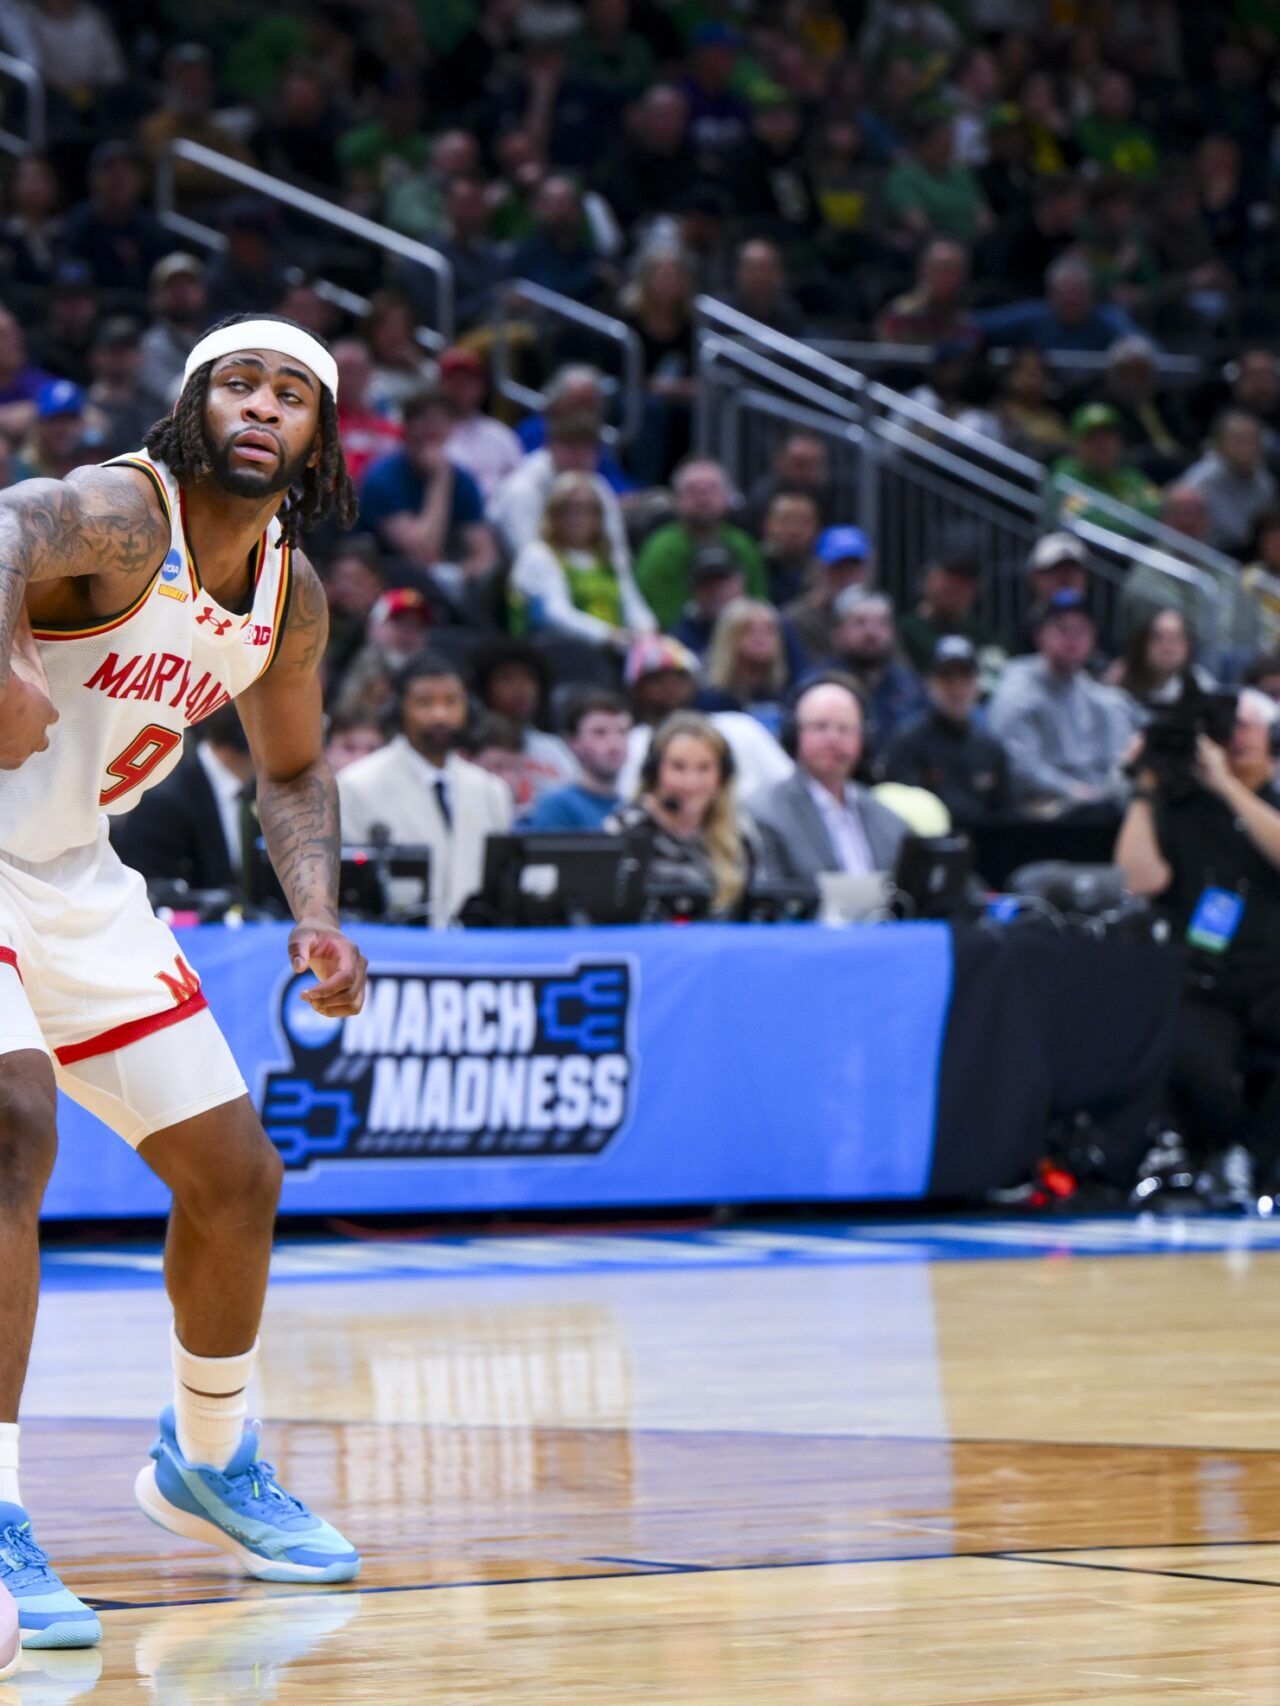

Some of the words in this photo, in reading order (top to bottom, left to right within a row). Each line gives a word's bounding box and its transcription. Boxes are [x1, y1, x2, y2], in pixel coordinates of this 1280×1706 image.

[99, 723, 182, 806] 9
[342, 978, 538, 1055] MARCH
[366, 1053, 628, 1133] MADNESS
